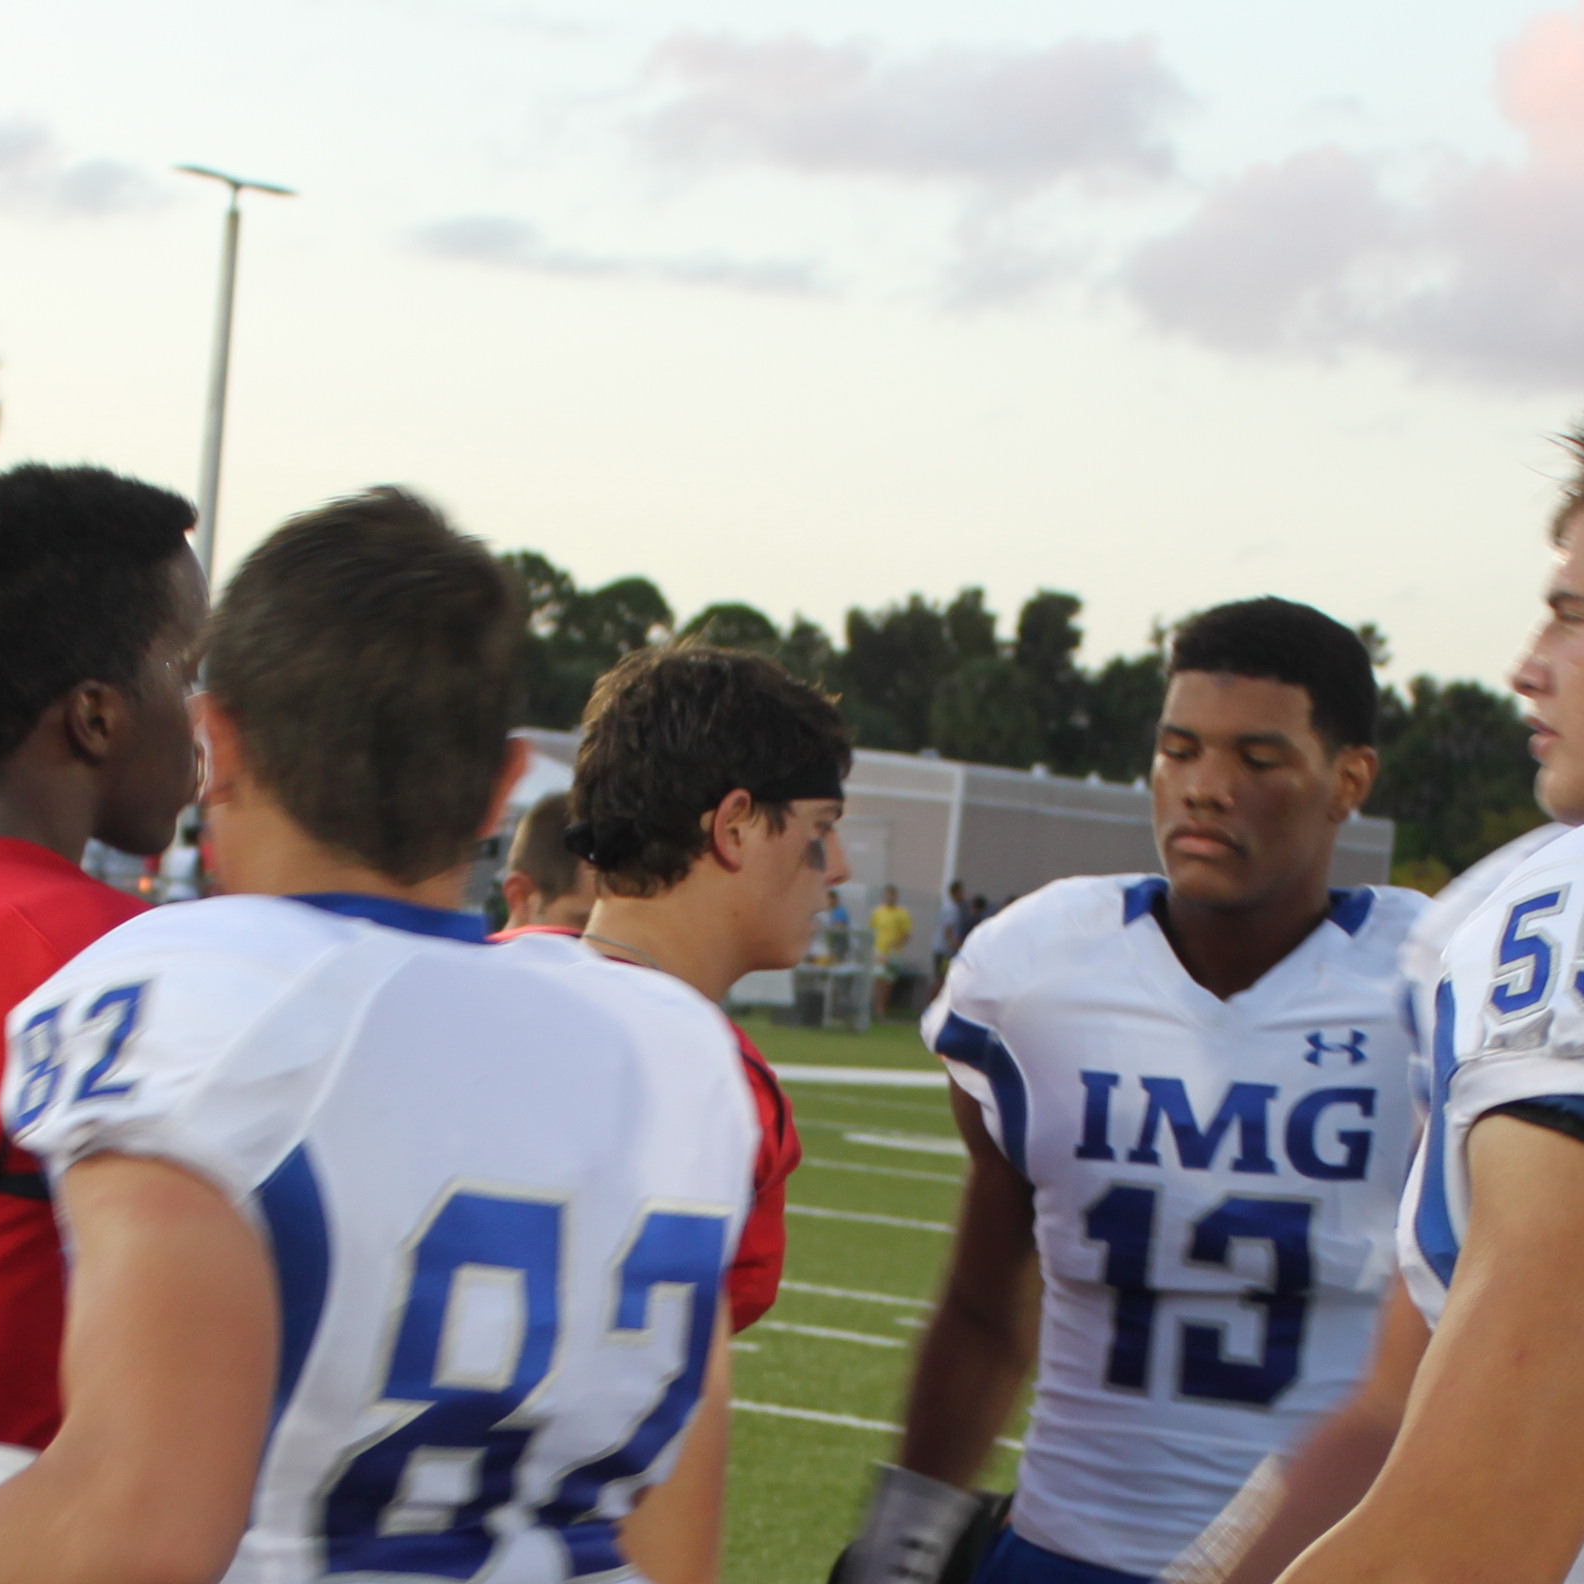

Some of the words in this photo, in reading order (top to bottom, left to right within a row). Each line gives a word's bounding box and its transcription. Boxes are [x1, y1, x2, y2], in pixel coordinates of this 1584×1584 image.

[9, 976, 156, 1141] 82
[1074, 1069, 1378, 1181] IMG
[1081, 1179, 1322, 1409] 13
